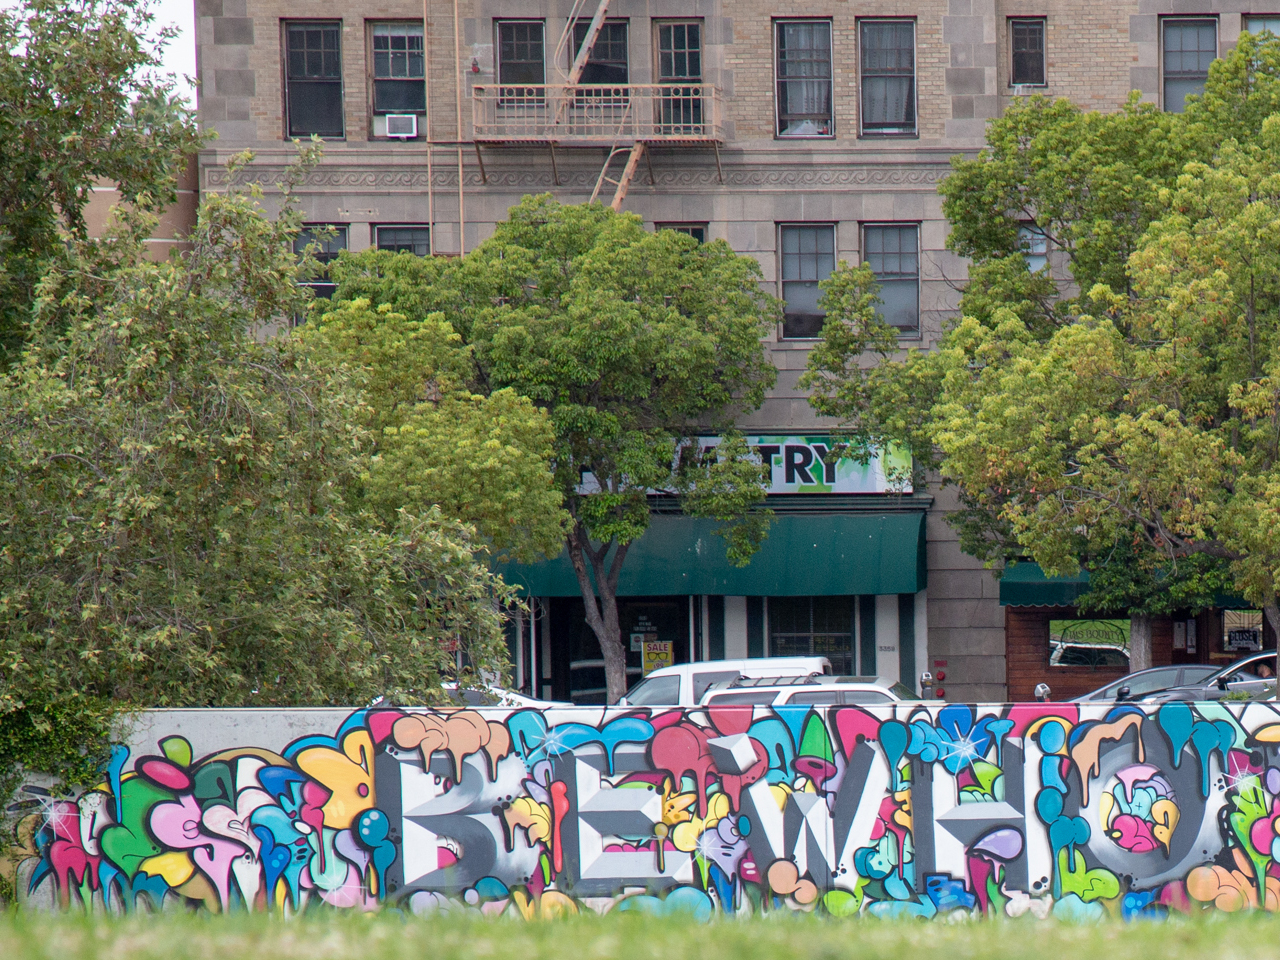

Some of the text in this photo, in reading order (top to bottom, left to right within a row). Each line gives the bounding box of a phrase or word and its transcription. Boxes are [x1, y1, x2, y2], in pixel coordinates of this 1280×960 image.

[646, 643, 669, 651] SALE
[374, 738, 694, 898] BE
[706, 716, 1228, 893] WHO
